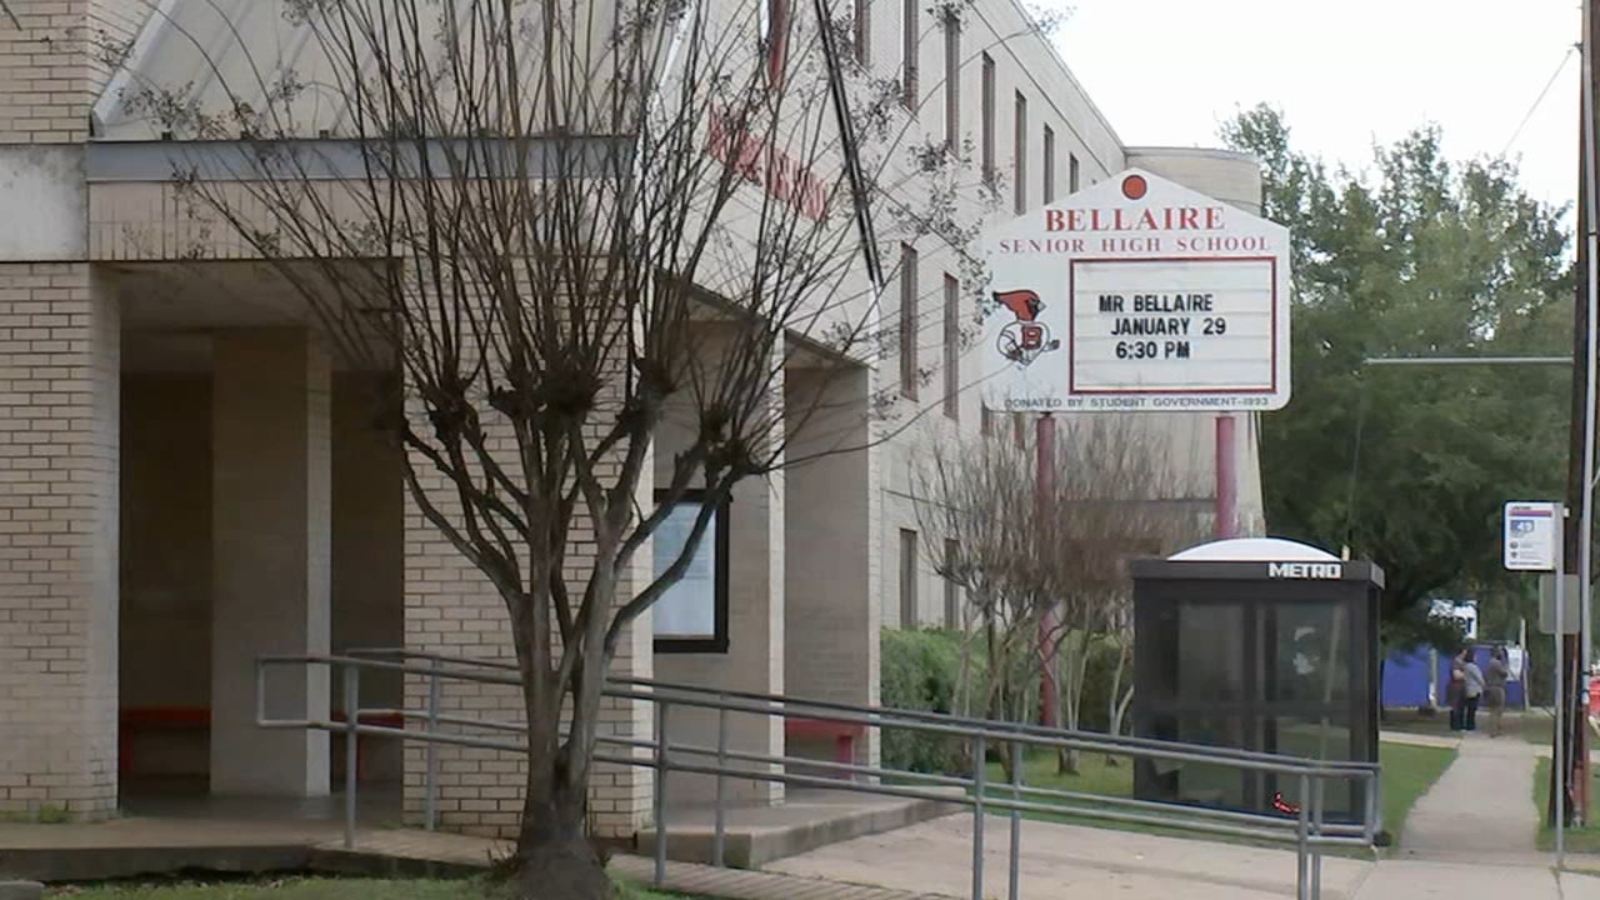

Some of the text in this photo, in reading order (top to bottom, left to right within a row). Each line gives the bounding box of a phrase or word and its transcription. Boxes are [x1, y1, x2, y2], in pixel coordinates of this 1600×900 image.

[1045, 207, 1226, 232] BELLAIRE
[999, 236, 1271, 254] SENIOR HIGH SCHOOL
[1098, 293, 1214, 313] MR BELLAIRE
[1110, 317, 1227, 336] JANUARY 29
[1115, 340, 1191, 360] 6:30 PM
[1004, 397, 1063, 409] DONATED
[1067, 398, 1084, 408] BY
[1090, 397, 1147, 408] STUDENT
[1268, 562, 1342, 579] METRO
